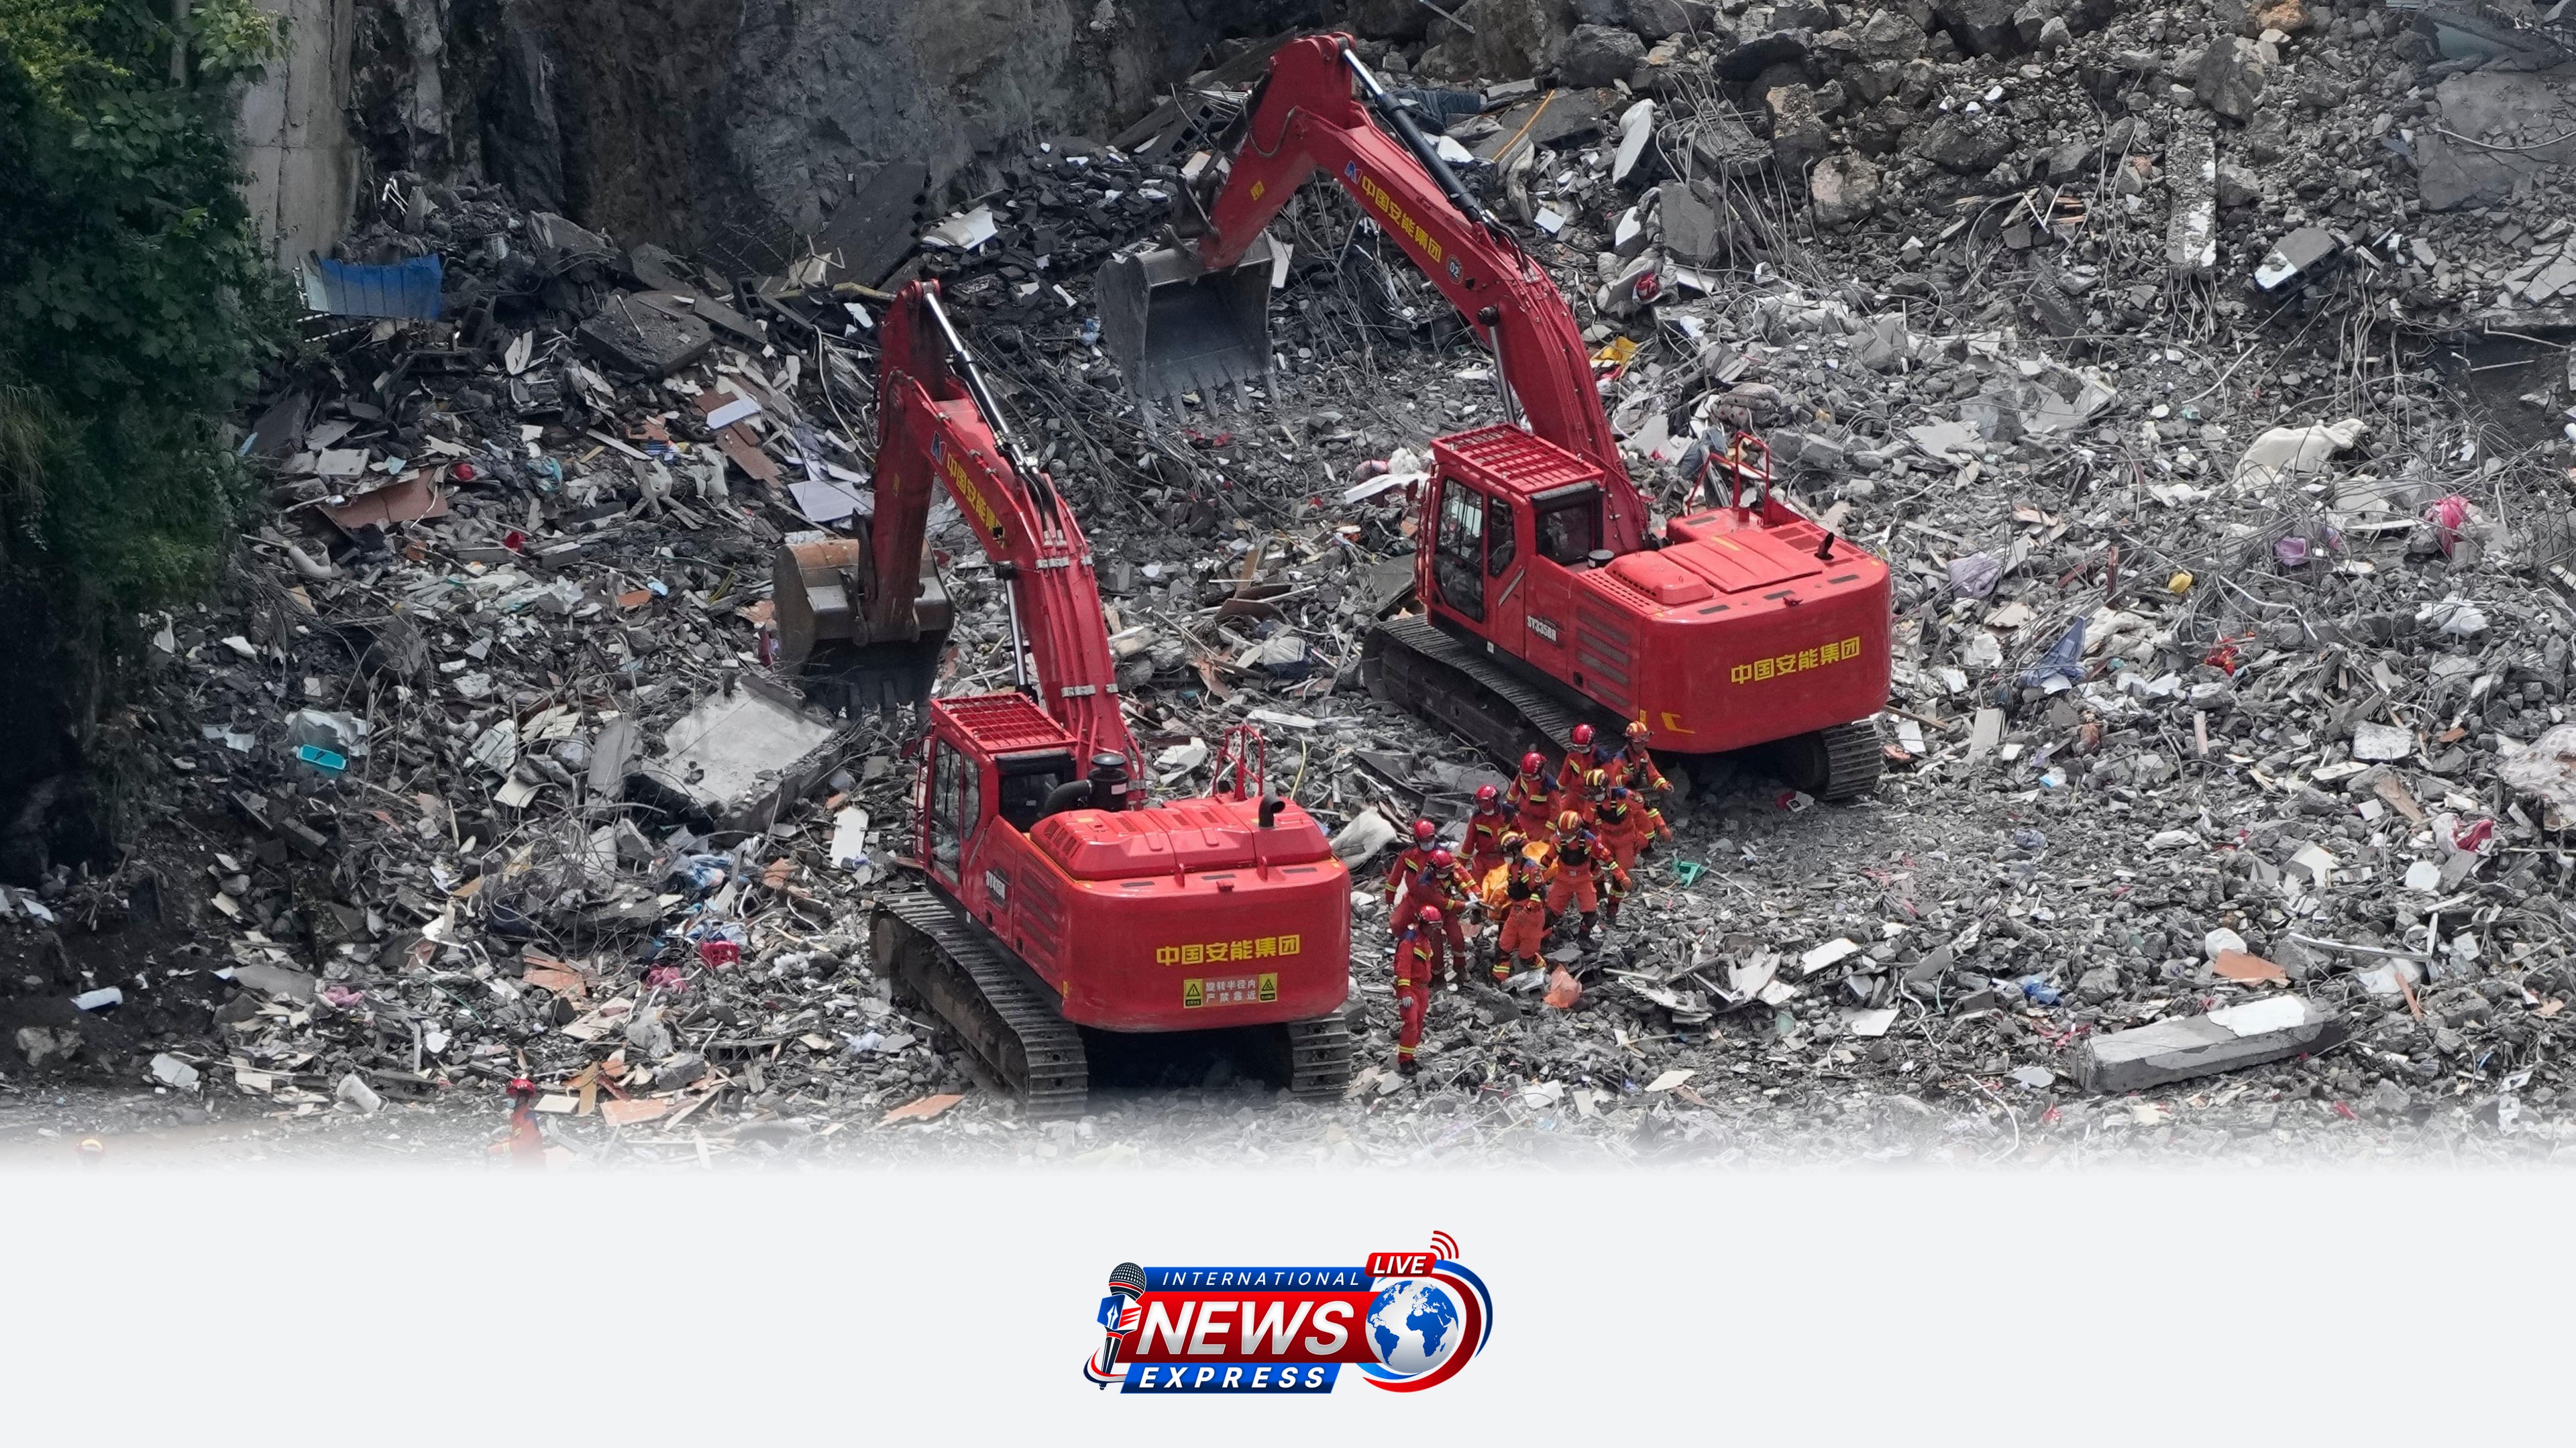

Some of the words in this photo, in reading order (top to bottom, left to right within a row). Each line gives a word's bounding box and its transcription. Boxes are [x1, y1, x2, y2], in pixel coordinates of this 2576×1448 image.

[1362, 176, 1441, 263] 中国安能集团
[1450, 262, 1458, 278] 02
[1731, 636, 1860, 684] 中国安能集团
[1157, 934, 1300, 966] 中国安能集团
